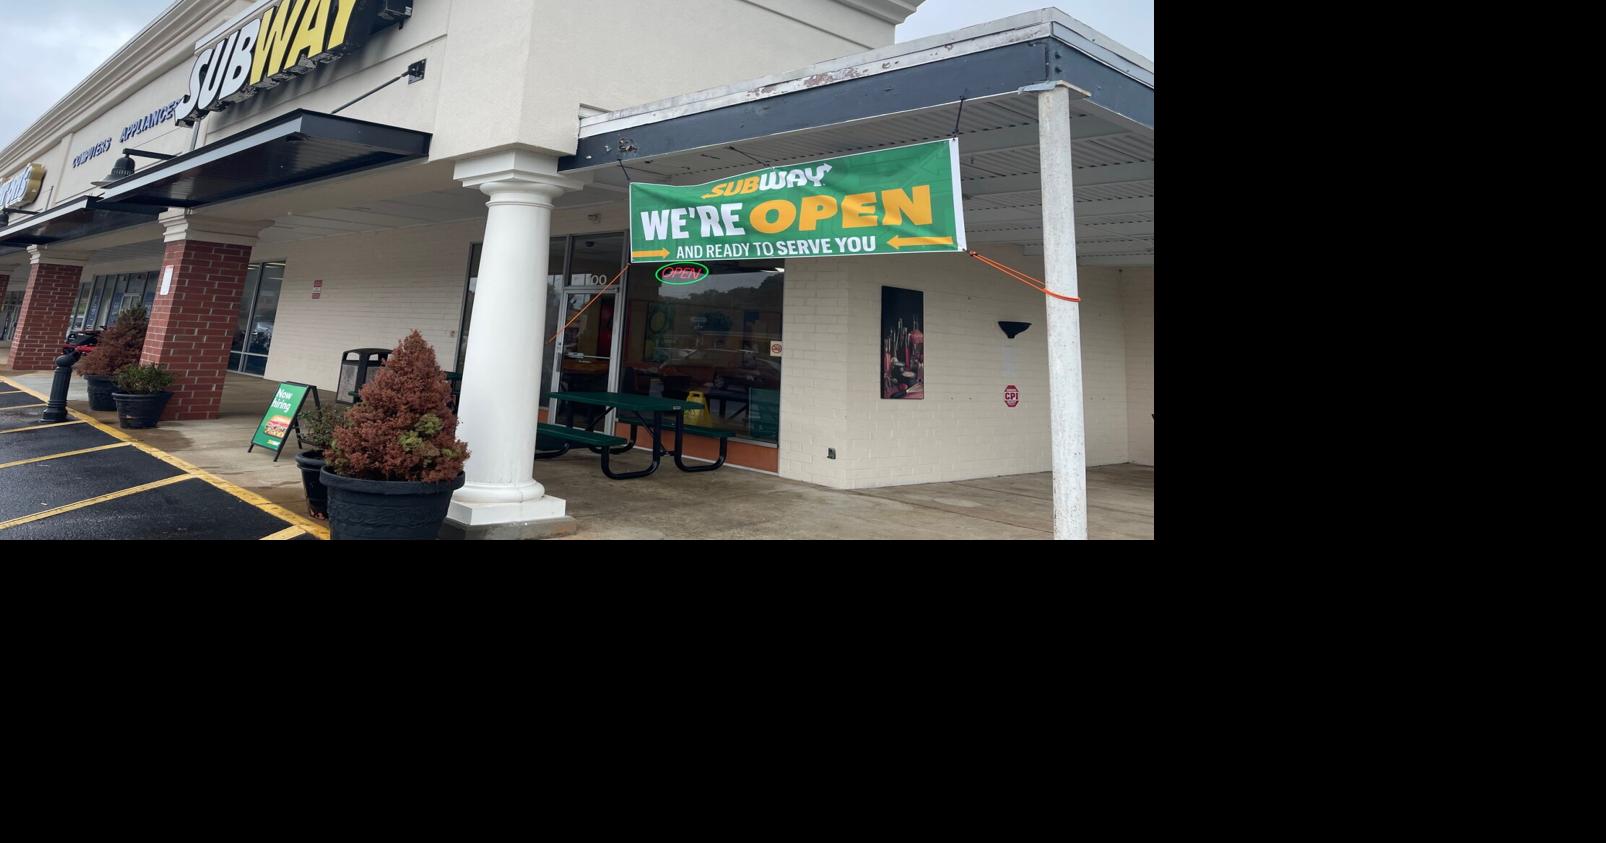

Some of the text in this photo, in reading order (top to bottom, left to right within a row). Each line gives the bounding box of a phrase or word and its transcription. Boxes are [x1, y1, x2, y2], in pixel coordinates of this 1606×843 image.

[701, 163, 832, 199] SUBWAY
[640, 184, 933, 241] WE'RE OPEN
[676, 235, 877, 259] AND READY TO SERVE YOU
[662, 266, 702, 279] OPEN
[276, 388, 293, 399] Now
[1005, 392, 1019, 400] CPI
[272, 398, 291, 413] hiring
